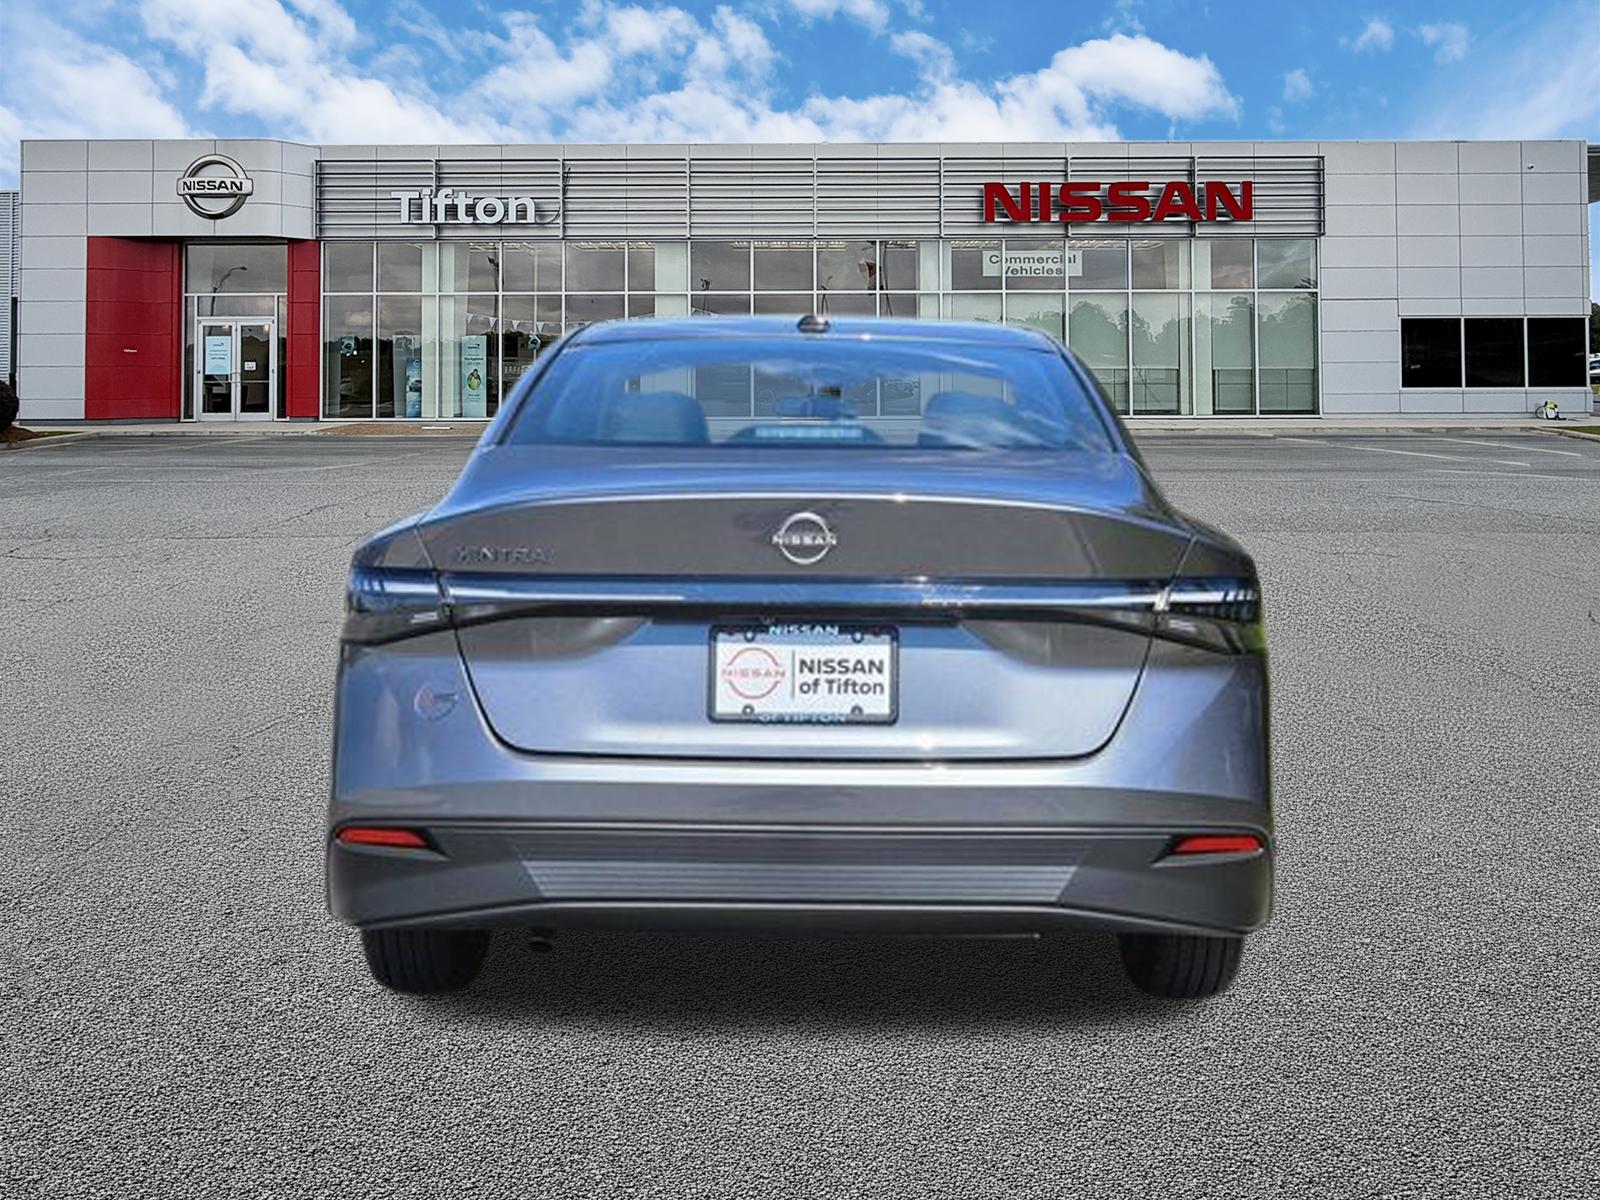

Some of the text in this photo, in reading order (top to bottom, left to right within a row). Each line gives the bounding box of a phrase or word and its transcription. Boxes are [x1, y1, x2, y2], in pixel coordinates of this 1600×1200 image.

[182, 180, 243, 192] NISSAN
[391, 188, 536, 224] Tifton
[983, 181, 1254, 222] NISSAN
[771, 534, 837, 545] NISSAN
[769, 624, 840, 636] NISSAN
[720, 667, 786, 678] NISSAN
[800, 658, 884, 675] NISSAN
[799, 678, 885, 695] of Tifton
